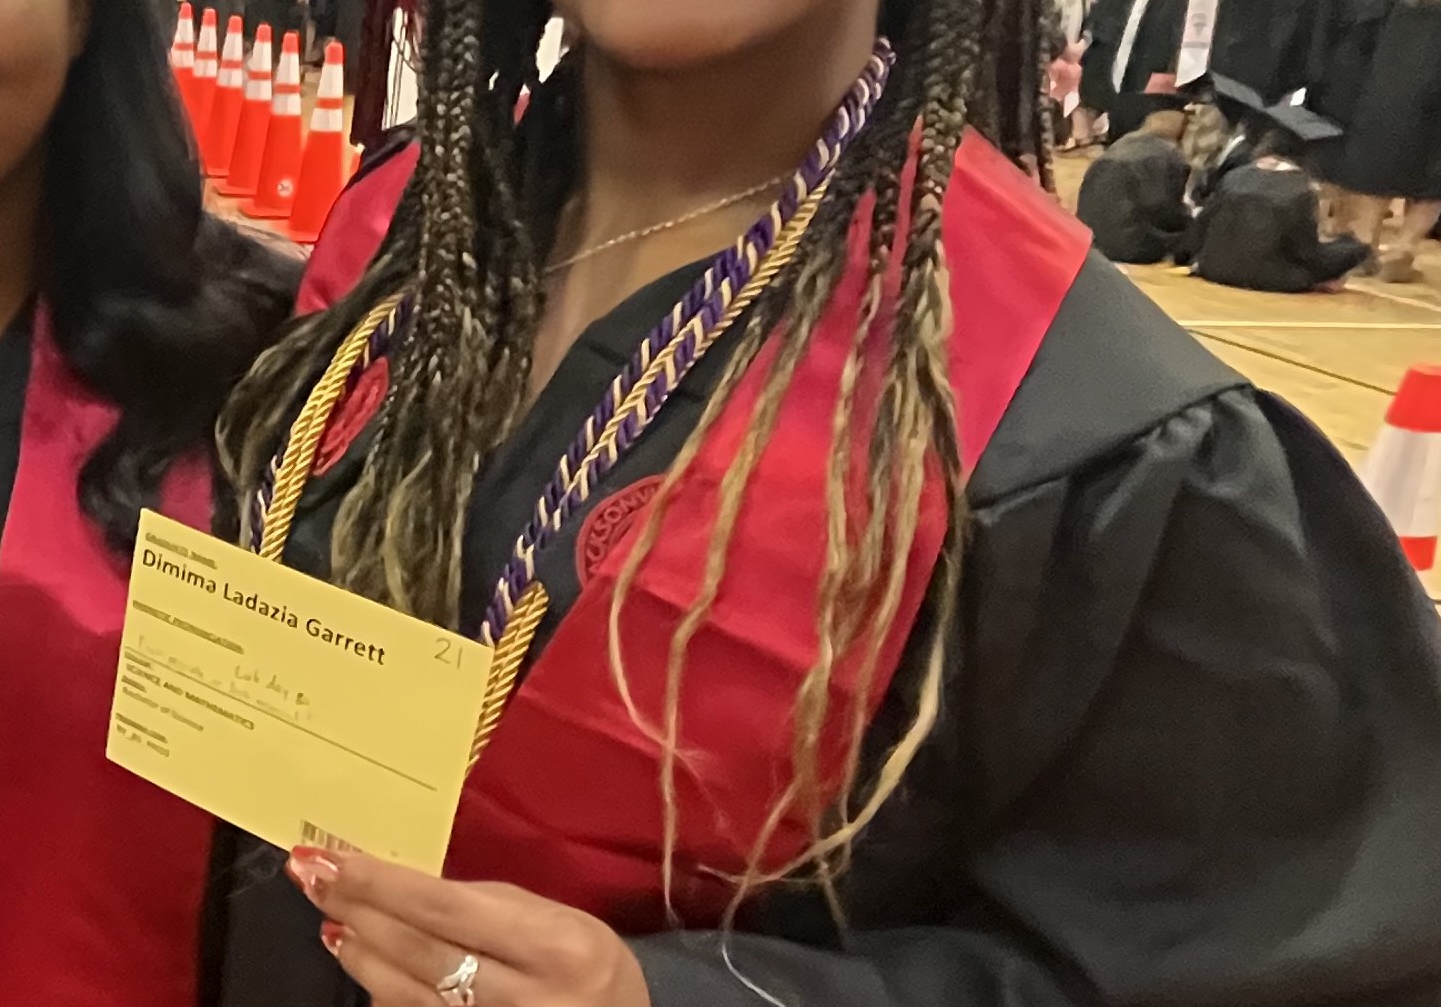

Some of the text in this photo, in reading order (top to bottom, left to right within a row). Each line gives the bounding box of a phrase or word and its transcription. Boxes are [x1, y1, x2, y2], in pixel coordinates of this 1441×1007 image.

[142, 548, 217, 594] Dimima
[222, 582, 299, 628] Ladazia
[305, 617, 386, 666] Garrett
[433, 637, 463, 670] 21
